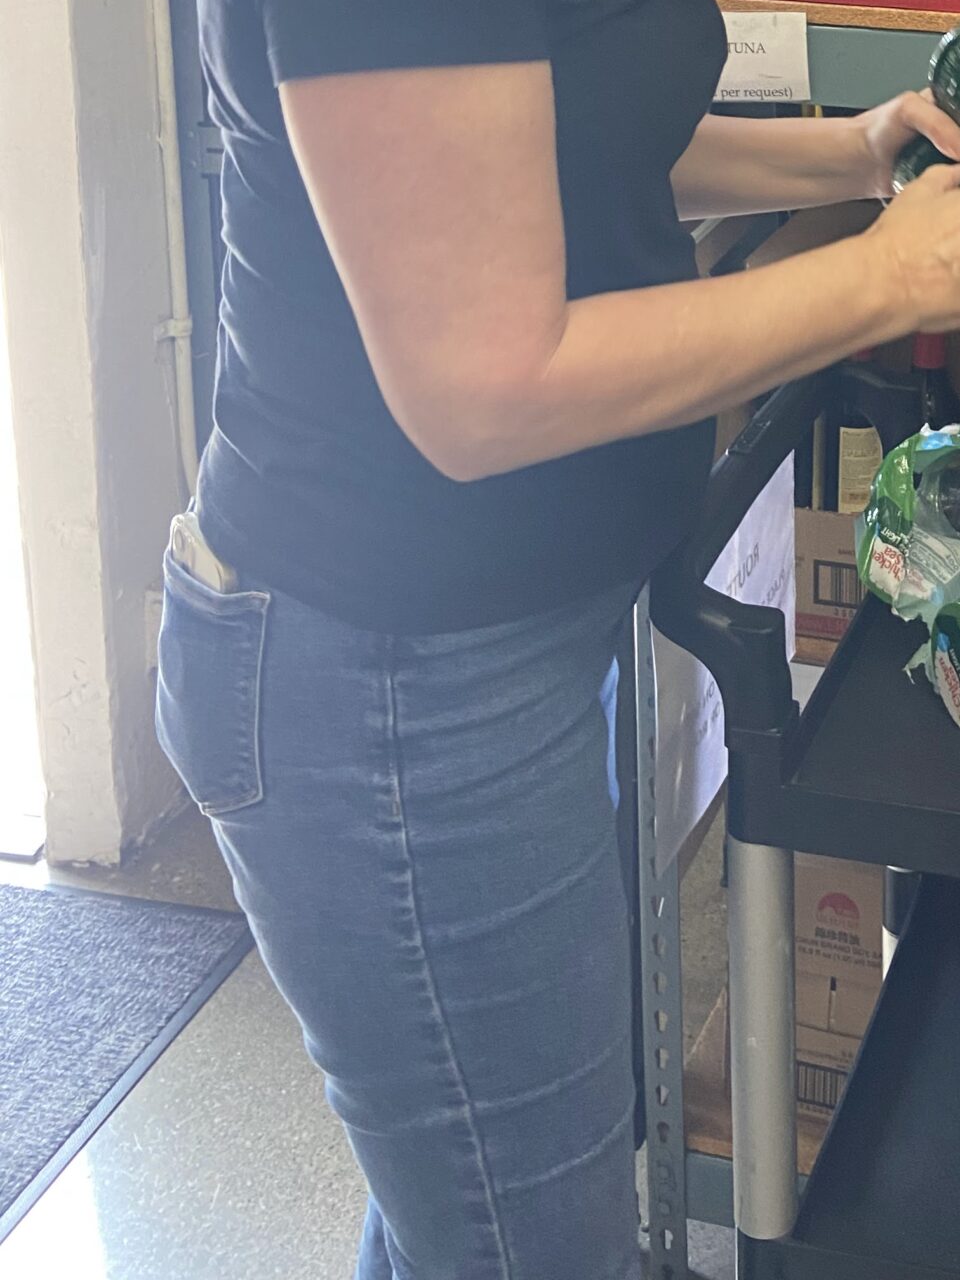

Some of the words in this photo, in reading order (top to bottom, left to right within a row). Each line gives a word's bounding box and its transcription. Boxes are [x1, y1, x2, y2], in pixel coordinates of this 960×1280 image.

[728, 42, 766, 54] TUNA
[721, 89, 740, 100] per
[744, 86, 793, 101] request)
